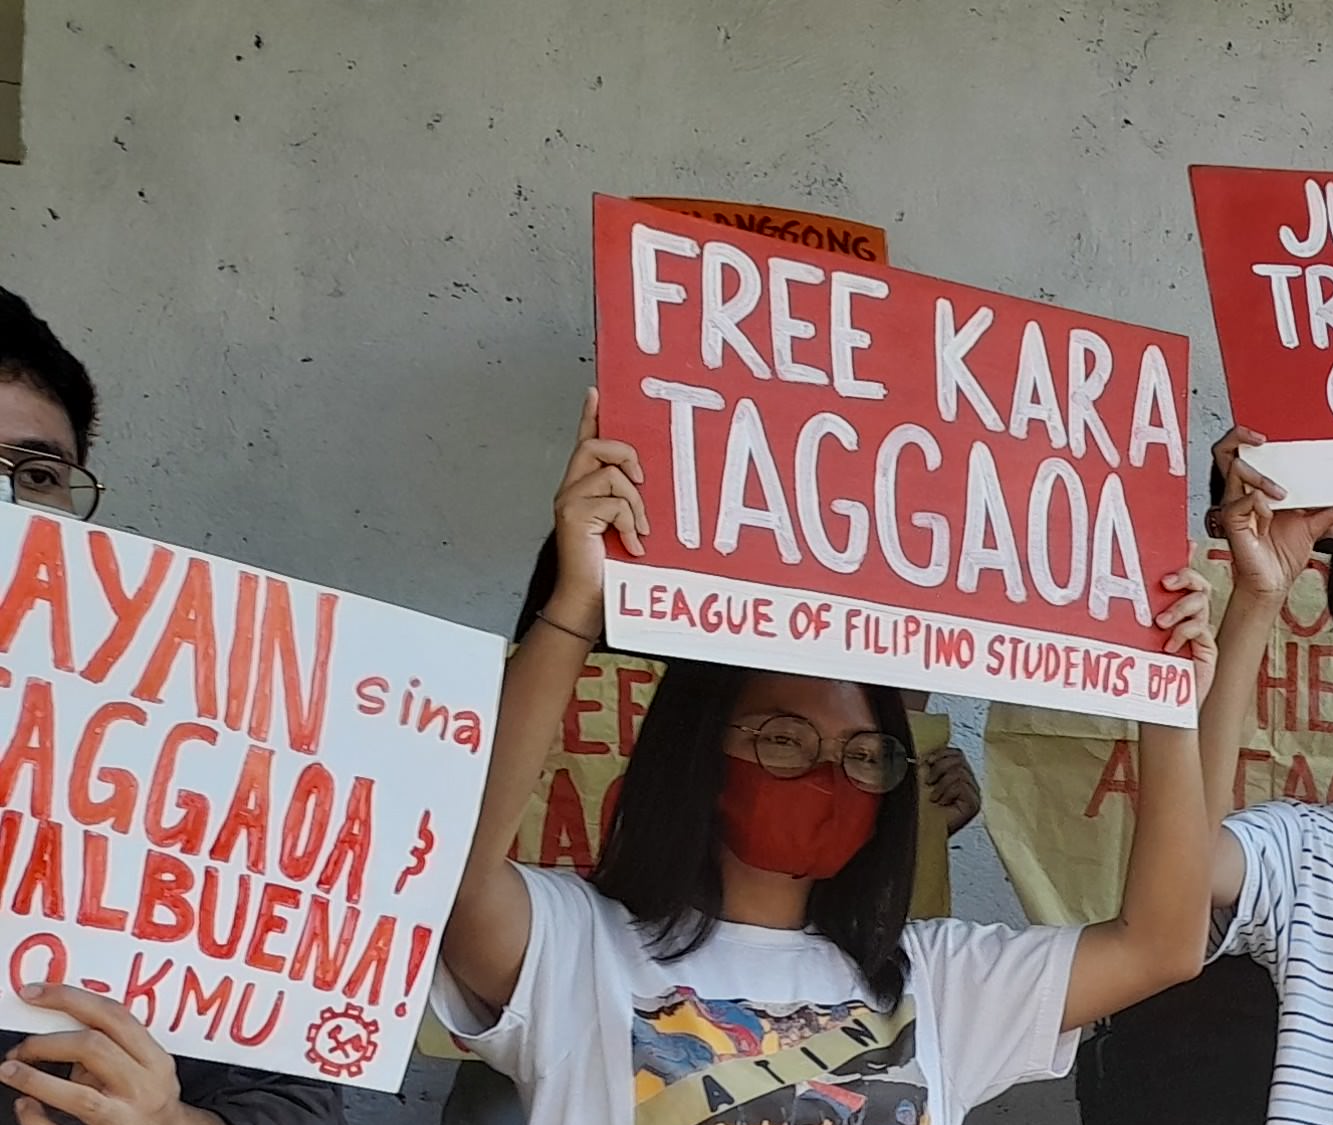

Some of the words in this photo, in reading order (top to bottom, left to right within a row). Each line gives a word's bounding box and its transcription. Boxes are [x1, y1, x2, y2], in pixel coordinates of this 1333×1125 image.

[631, 222, 891, 400] FREE
[934, 297, 1187, 477] KARA
[640, 377, 1153, 629] TAGGAOA
[354, 676, 482, 754] sina
[618, 582, 776, 639] LEAGUE
[789, 602, 831, 642] OF
[844, 615, 975, 671] FILIPINO
[985, 633, 1136, 697] STUDENTS
[0, 666, 375, 903] AGGAOA
